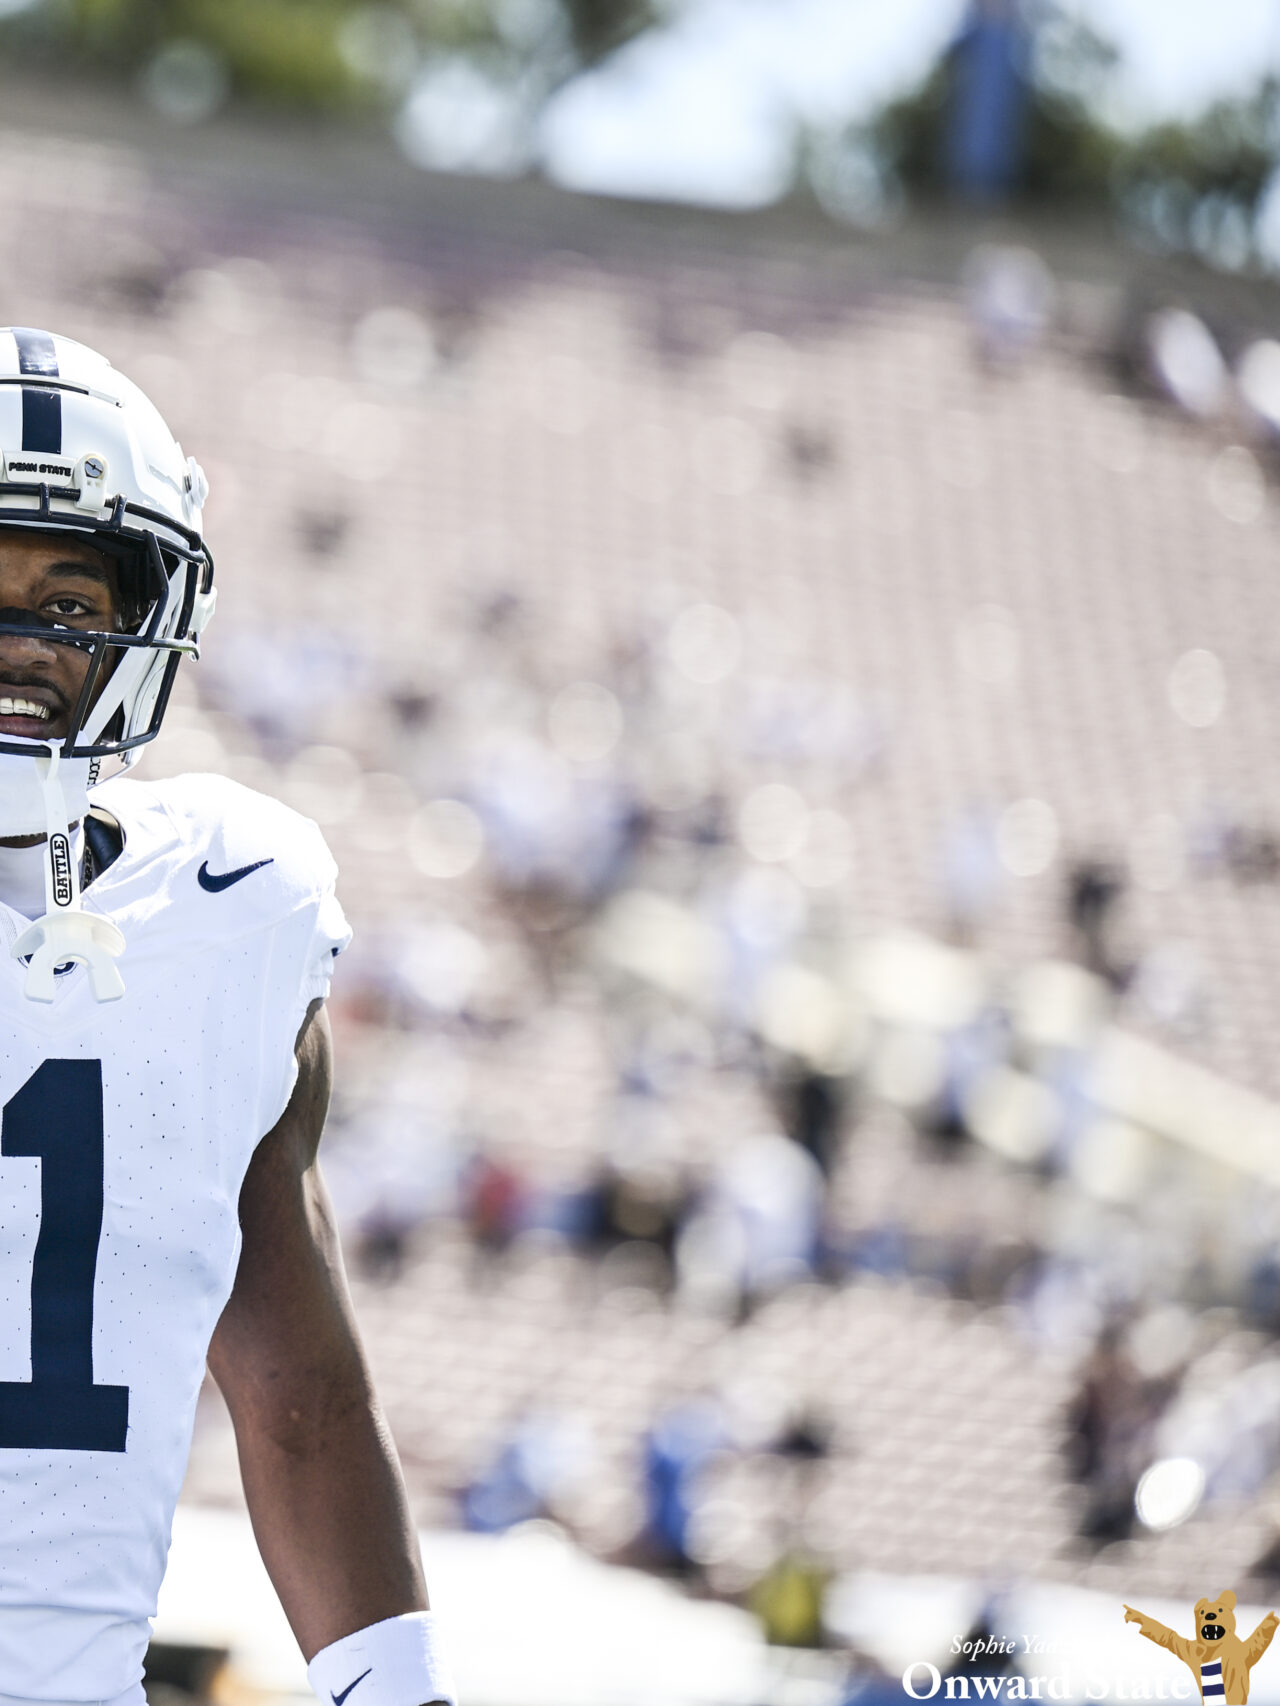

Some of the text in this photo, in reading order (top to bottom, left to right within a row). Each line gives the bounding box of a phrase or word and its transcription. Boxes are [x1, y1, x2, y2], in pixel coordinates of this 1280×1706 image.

[8, 462, 72, 477] PENN STATE
[53, 840, 69, 899] BATTLE
